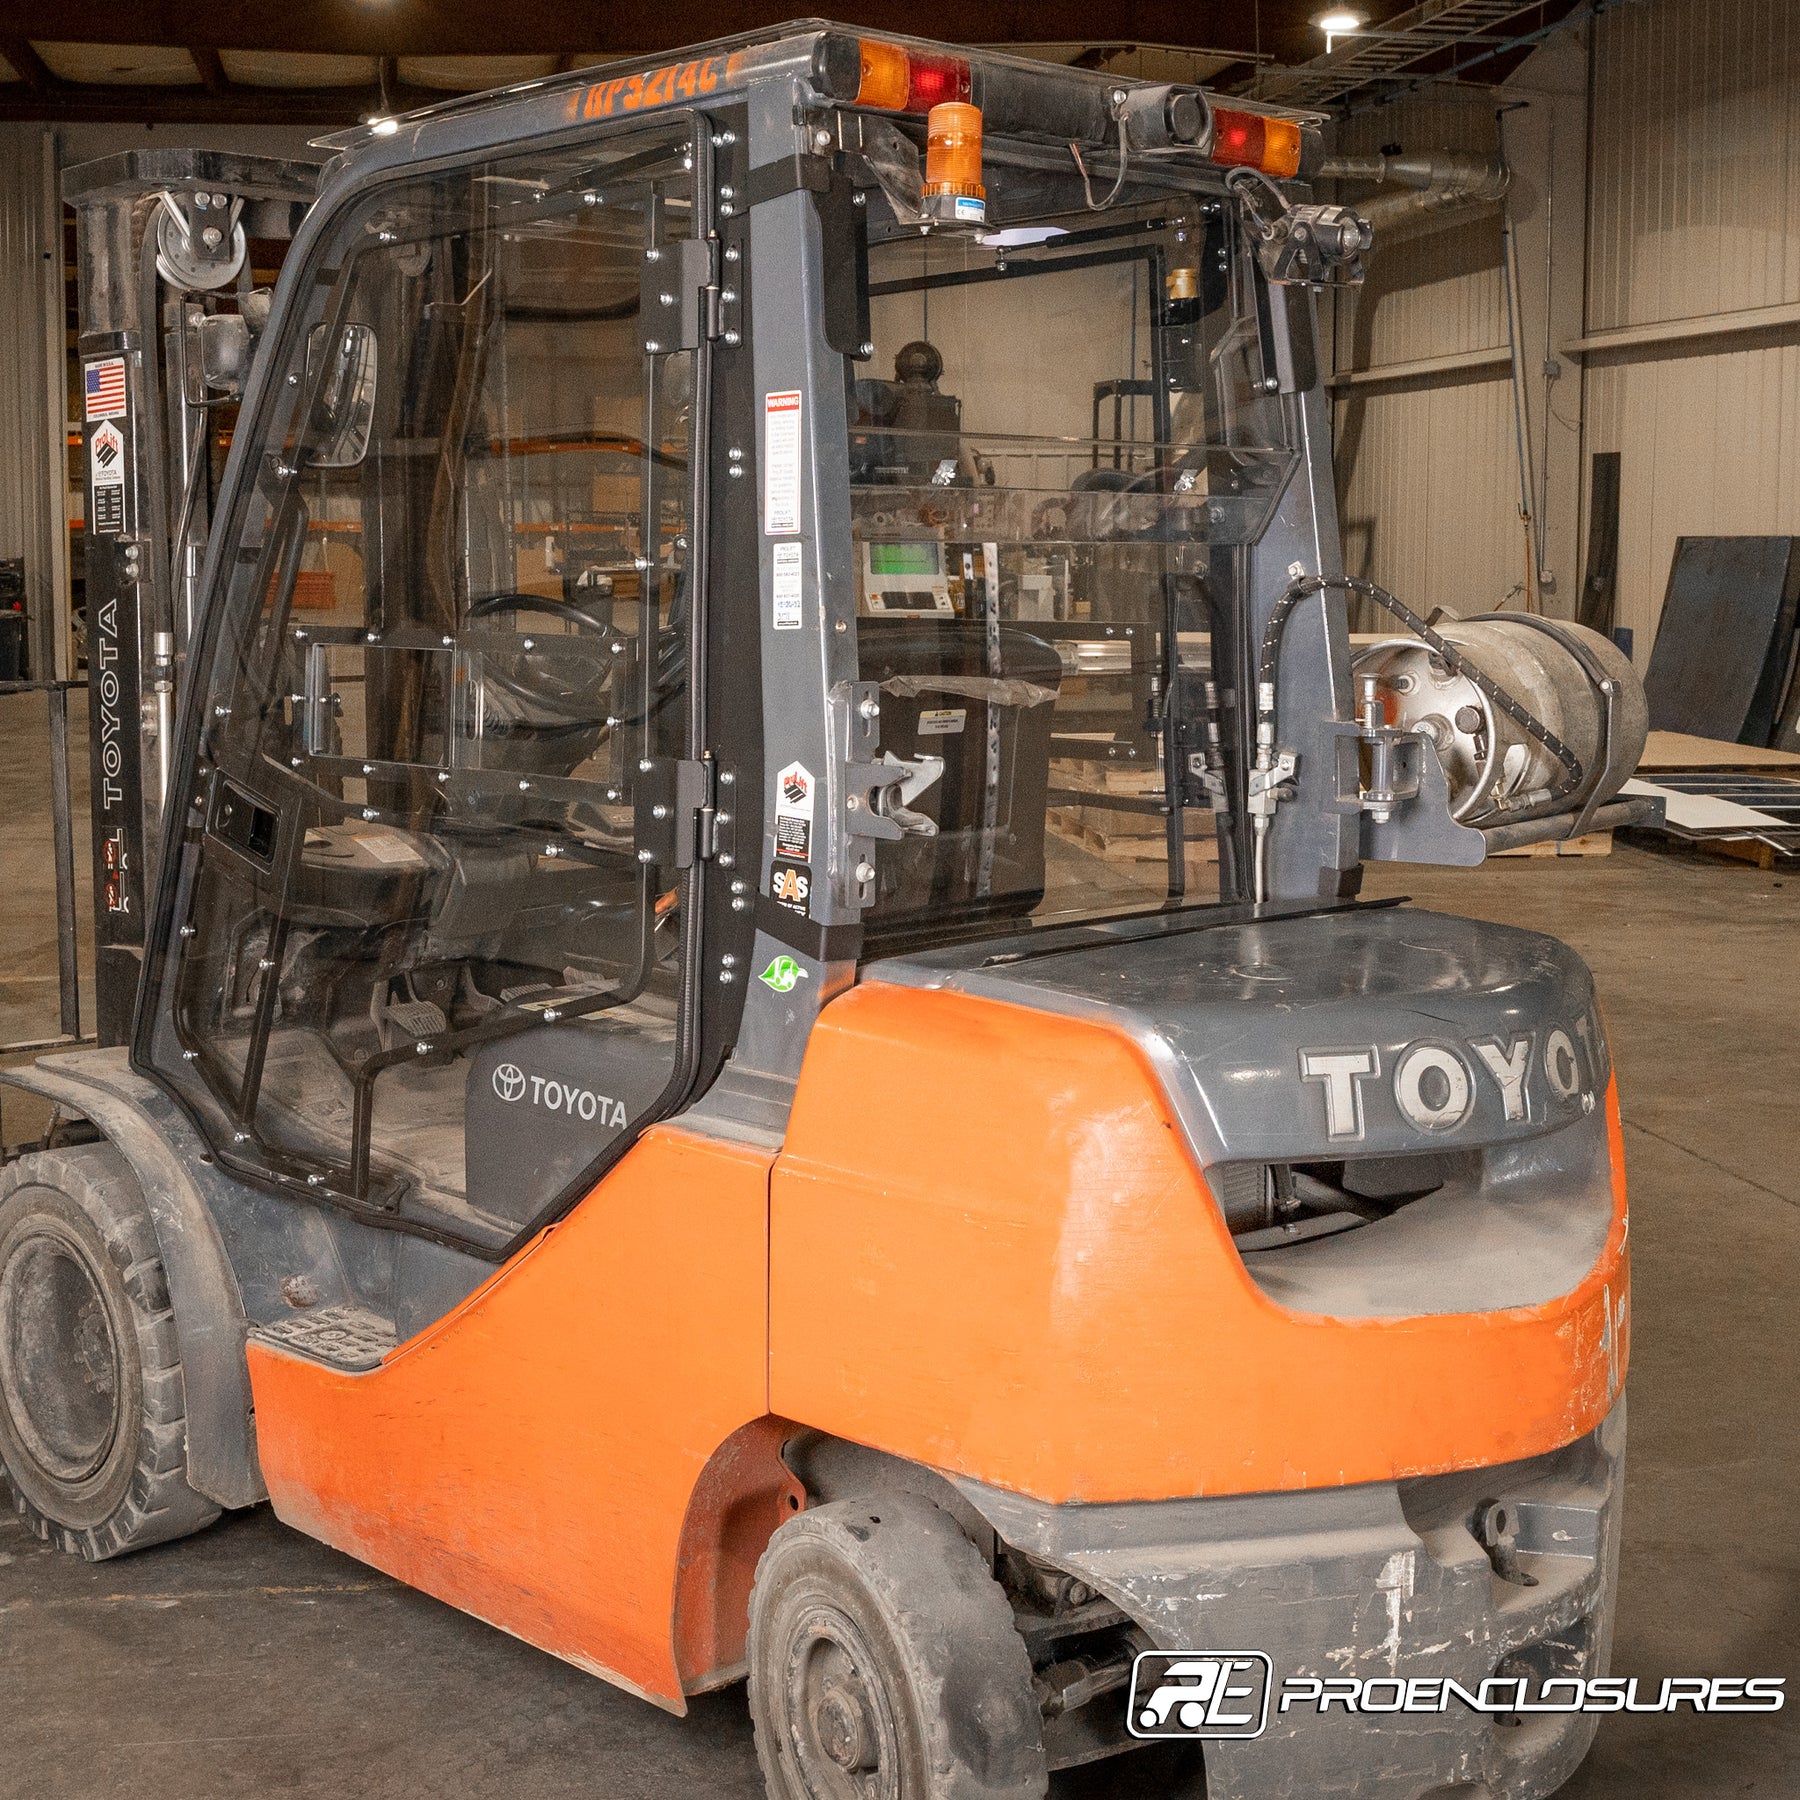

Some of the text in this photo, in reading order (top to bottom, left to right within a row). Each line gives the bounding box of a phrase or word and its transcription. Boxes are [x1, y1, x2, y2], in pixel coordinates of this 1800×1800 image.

[767, 395, 799, 408] WARNING
[99, 598, 122, 810] TOYOTA
[772, 869, 809, 902] SAS
[530, 1075, 628, 1130] TOYOTA
